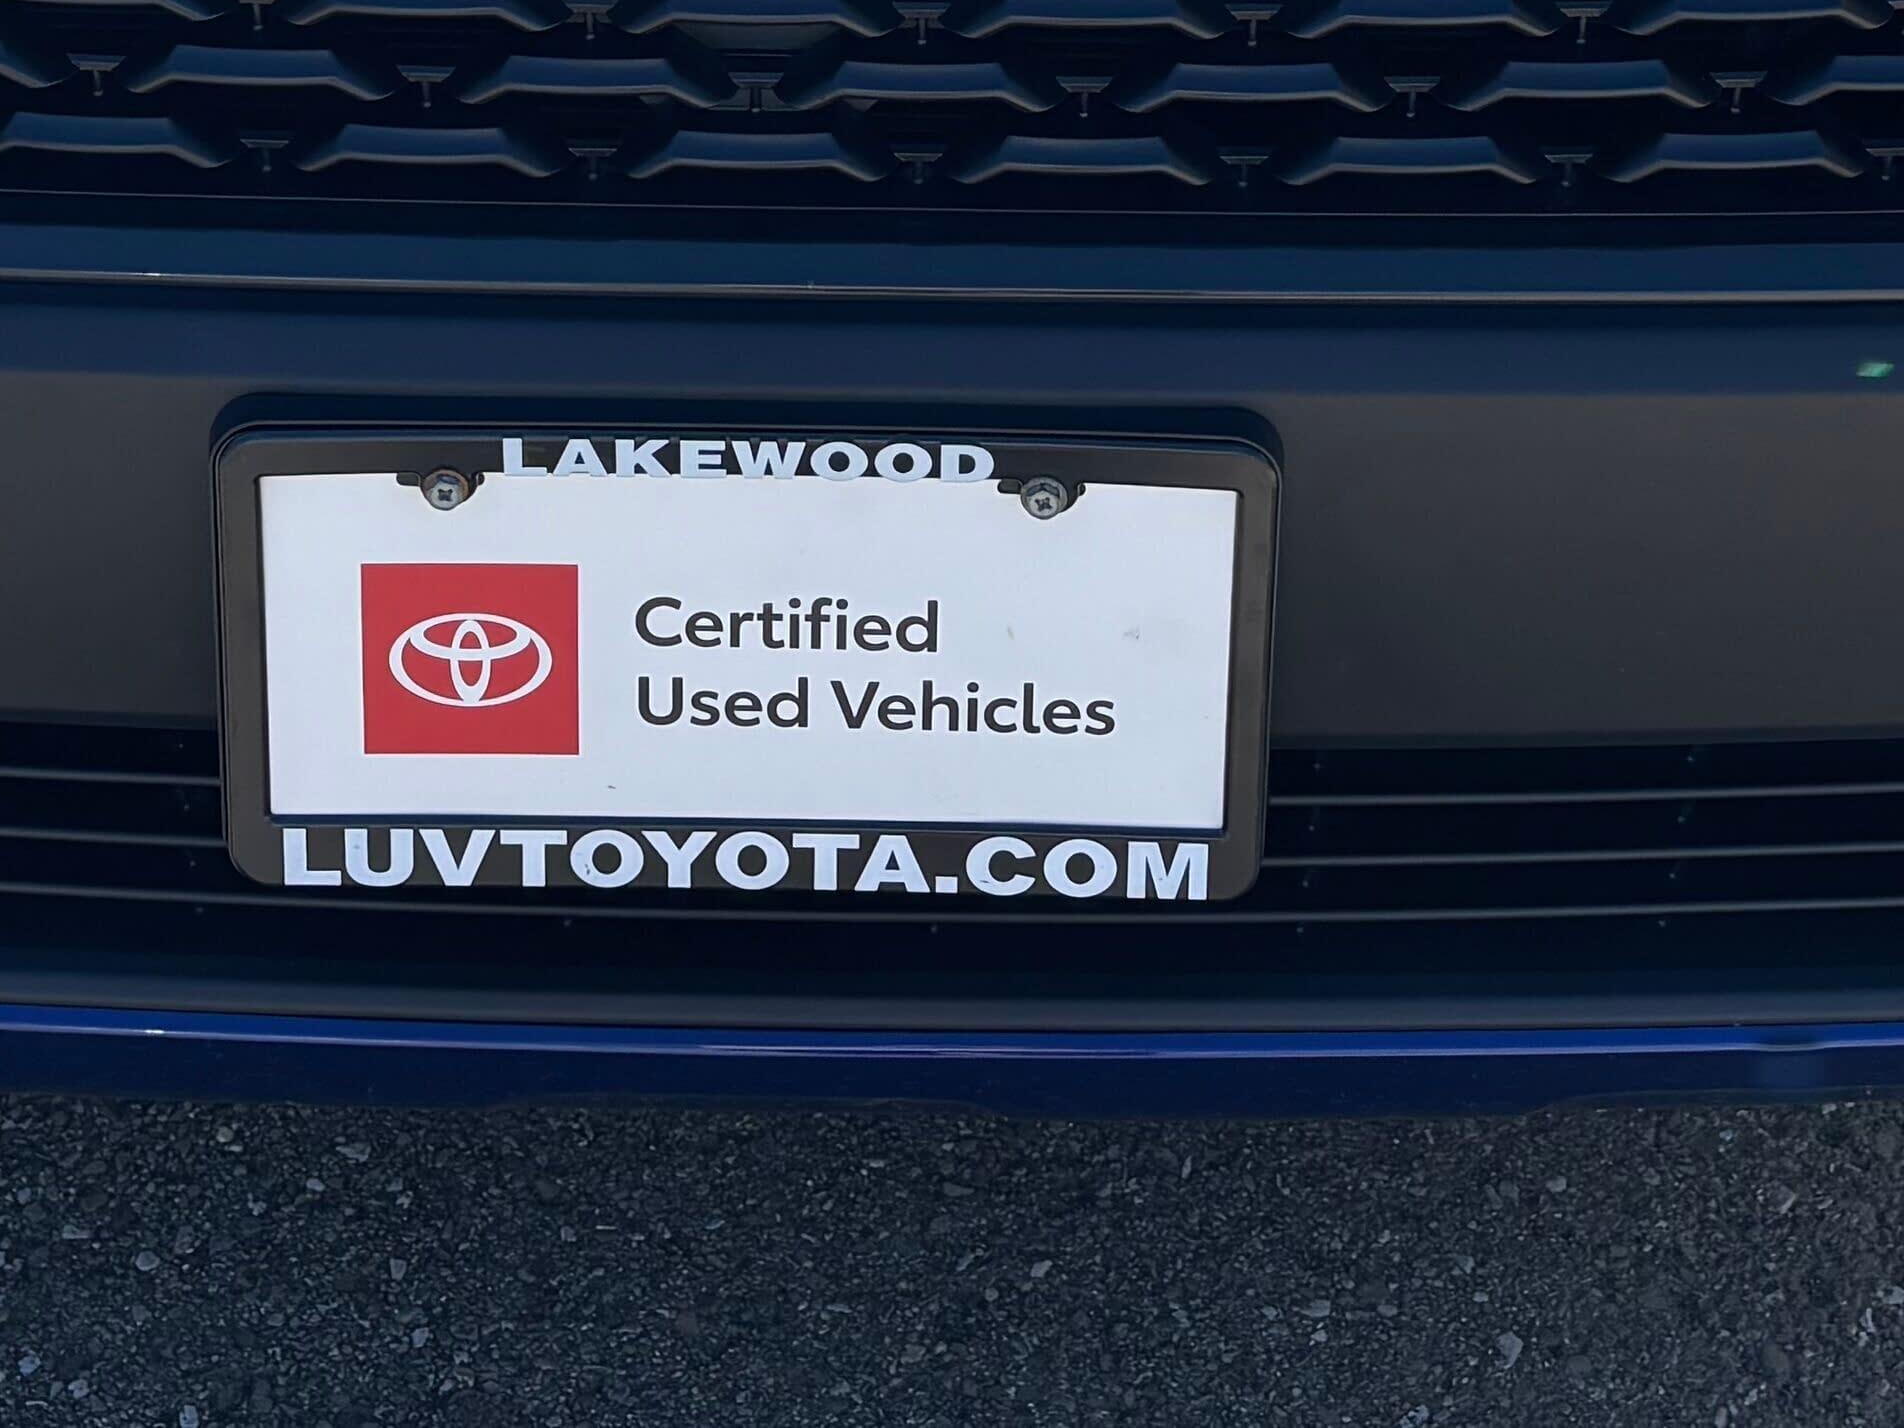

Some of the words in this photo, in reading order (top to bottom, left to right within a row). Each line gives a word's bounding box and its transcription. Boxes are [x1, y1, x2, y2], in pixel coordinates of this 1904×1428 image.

[502, 437, 995, 484] LAKEWOOD
[634, 596, 941, 654] Certified
[636, 677, 809, 729] Used
[831, 681, 1117, 737] Vehicles
[283, 828, 1210, 901] LUVTOYOTA.COM
